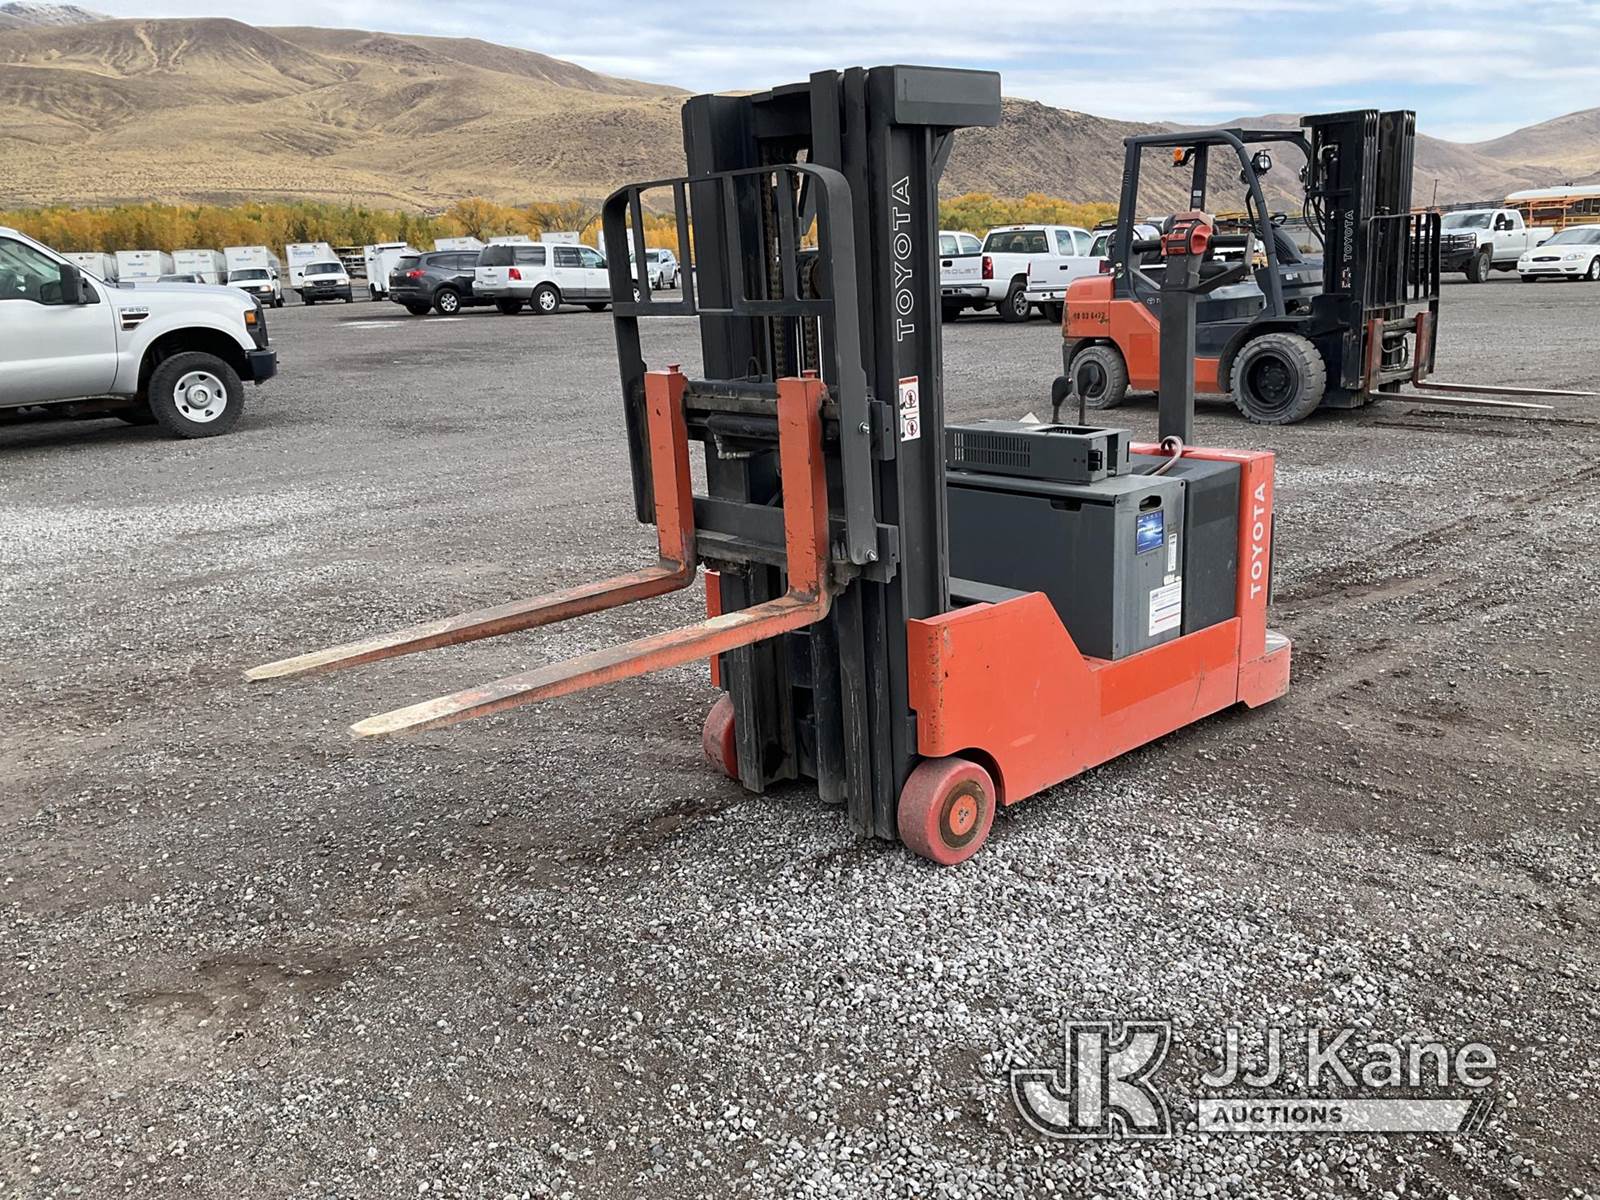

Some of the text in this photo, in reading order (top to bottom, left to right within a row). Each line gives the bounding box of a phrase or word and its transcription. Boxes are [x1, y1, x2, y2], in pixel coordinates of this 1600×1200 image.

[892, 176, 915, 341] TOYOTA
[1343, 210, 1353, 262] TOYOTA
[1251, 481, 1266, 600] TOYOTA
